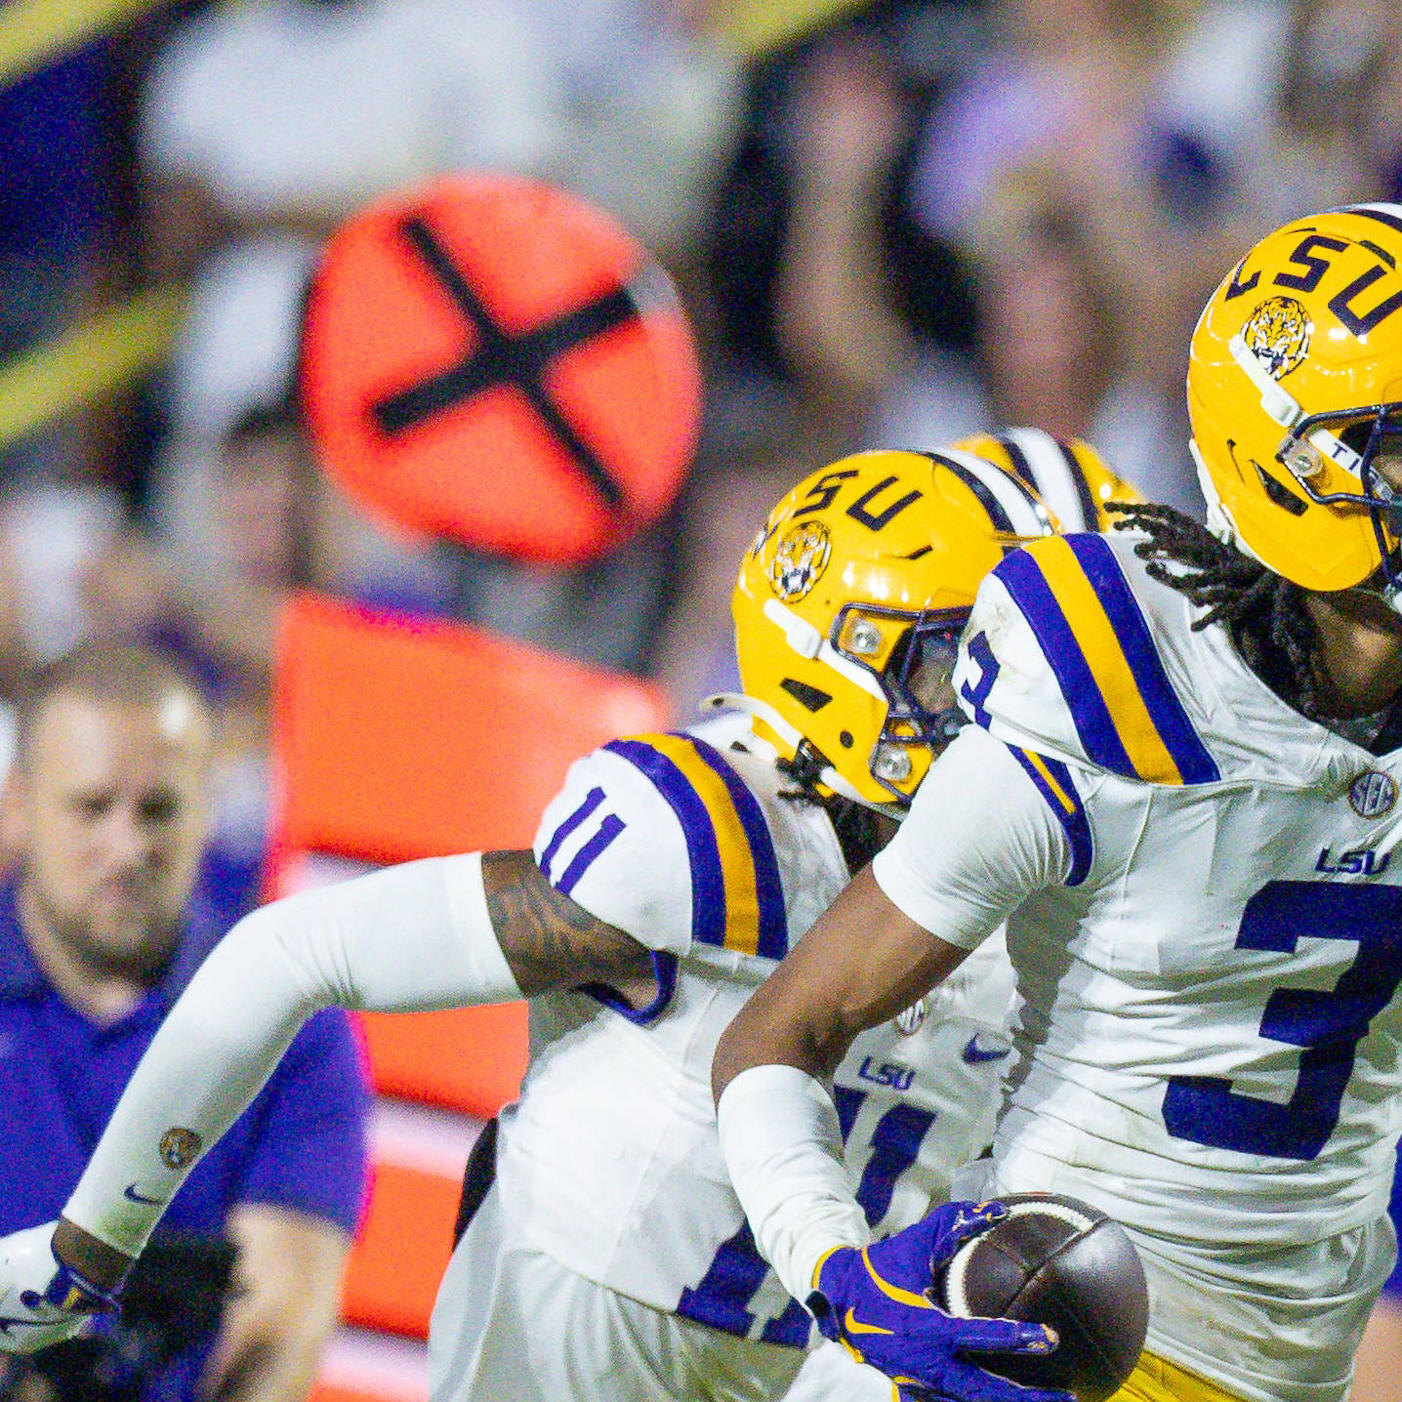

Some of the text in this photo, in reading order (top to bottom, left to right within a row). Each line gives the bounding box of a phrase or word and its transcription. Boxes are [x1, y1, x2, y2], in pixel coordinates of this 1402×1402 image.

[539, 786, 627, 895] 11
[1314, 847, 1391, 875] LSU
[859, 1055, 916, 1090] LSU
